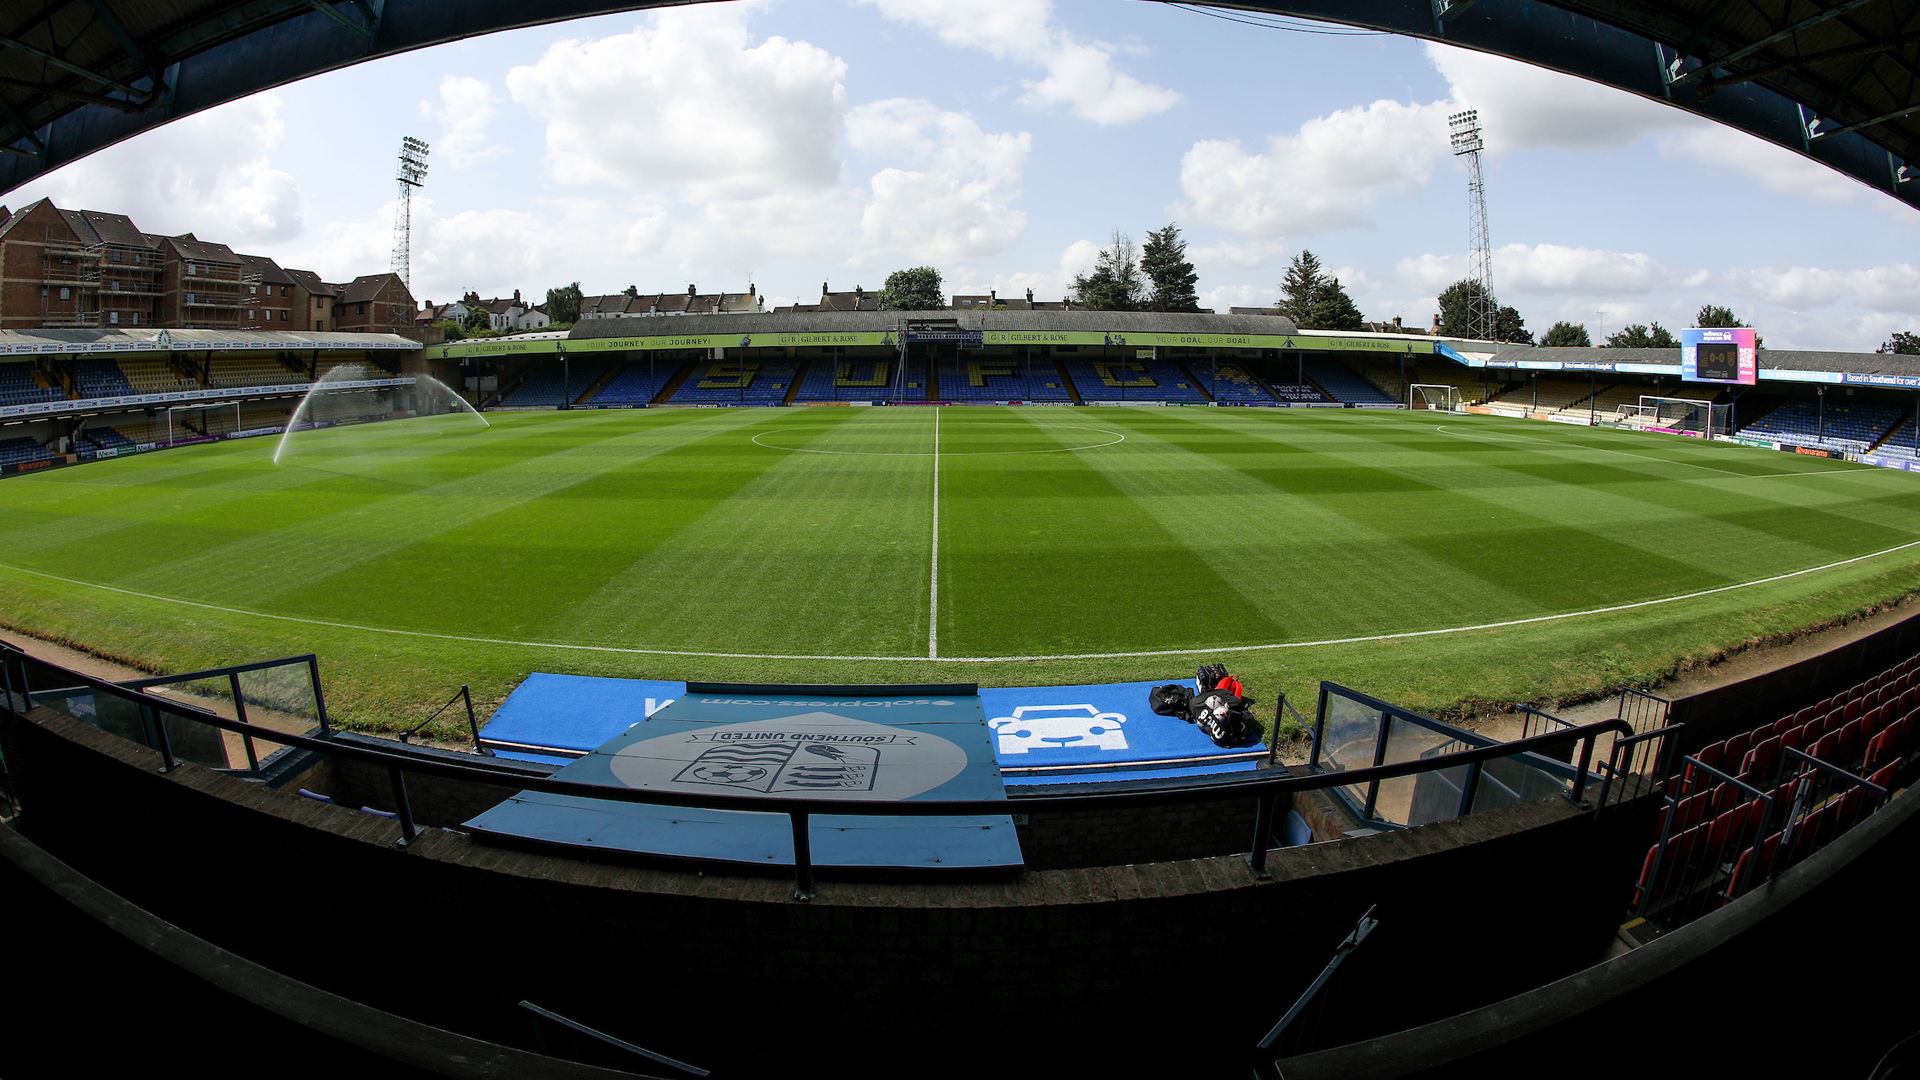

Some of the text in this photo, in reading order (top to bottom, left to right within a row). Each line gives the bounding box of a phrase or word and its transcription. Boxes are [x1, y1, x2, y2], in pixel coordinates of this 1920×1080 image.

[1847, 372, 1862, 382] Based
[1869, 375, 1896, 384] Southend
[701, 698, 931, 708] solopress.com
[720, 732, 886, 744] SOUTHEND UNITED
